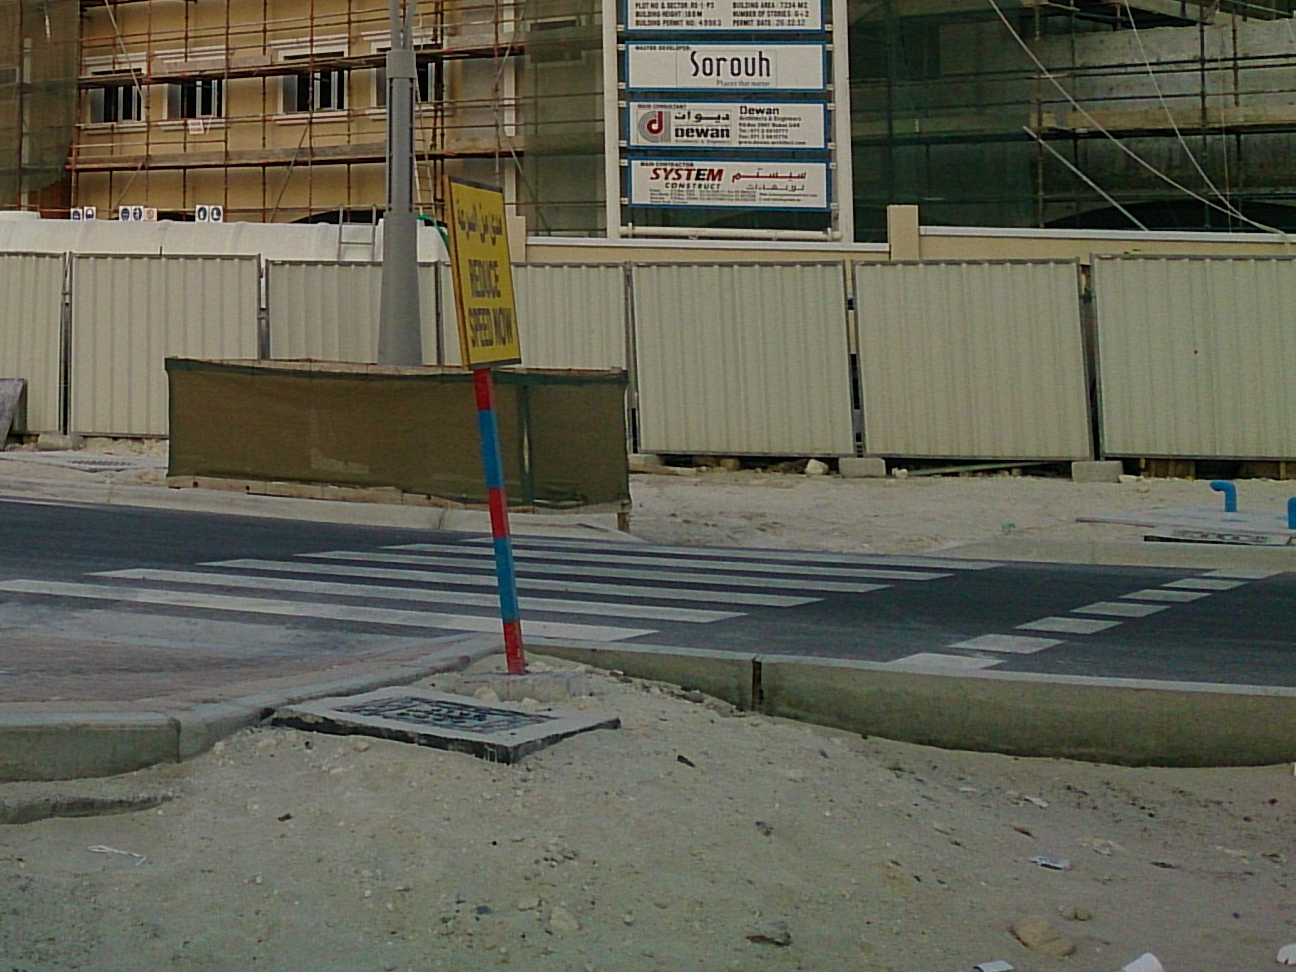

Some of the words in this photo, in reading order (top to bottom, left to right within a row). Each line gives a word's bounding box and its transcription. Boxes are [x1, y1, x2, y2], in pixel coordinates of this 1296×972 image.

[690, 50, 771, 77] Sorouh
[739, 105, 780, 115] Dewan
[650, 167, 724, 181] SYSTEM
[468, 259, 501, 298] REDUCE
[469, 307, 493, 347] SPEED
[492, 307, 513, 346] NOW
